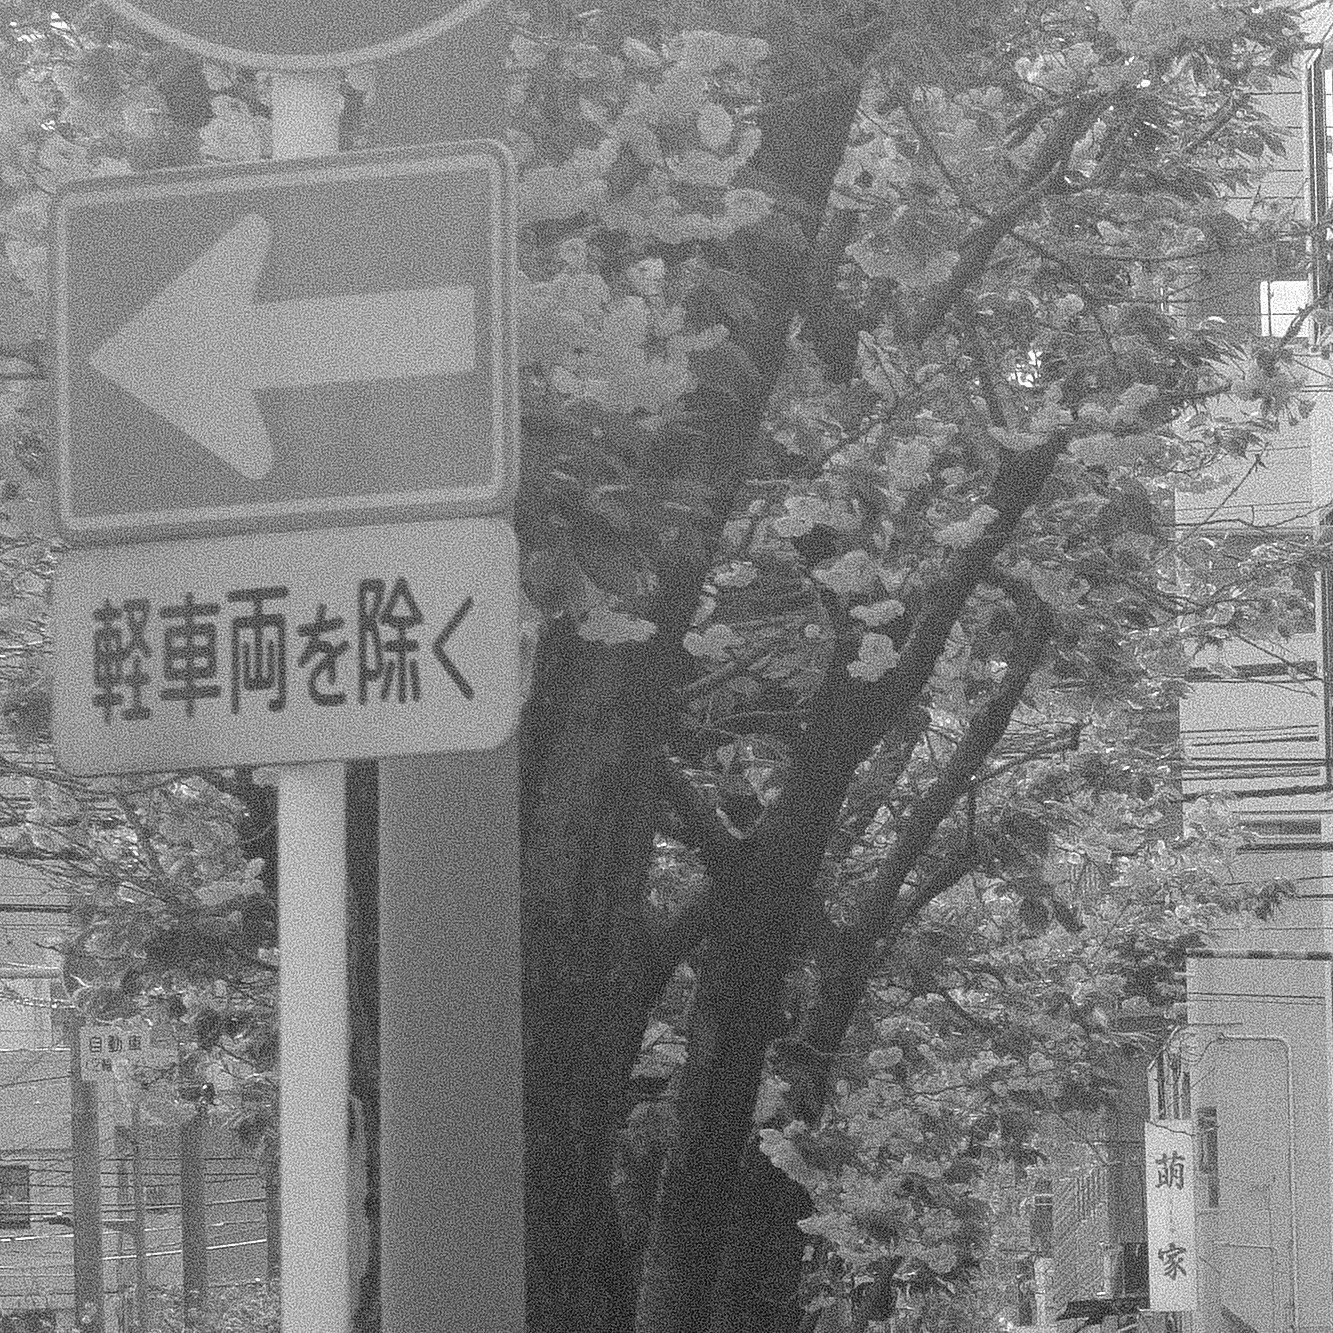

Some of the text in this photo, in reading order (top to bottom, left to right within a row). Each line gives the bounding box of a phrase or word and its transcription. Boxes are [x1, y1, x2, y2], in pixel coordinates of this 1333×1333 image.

[90, 575, 477, 726] 軽車両を除く
